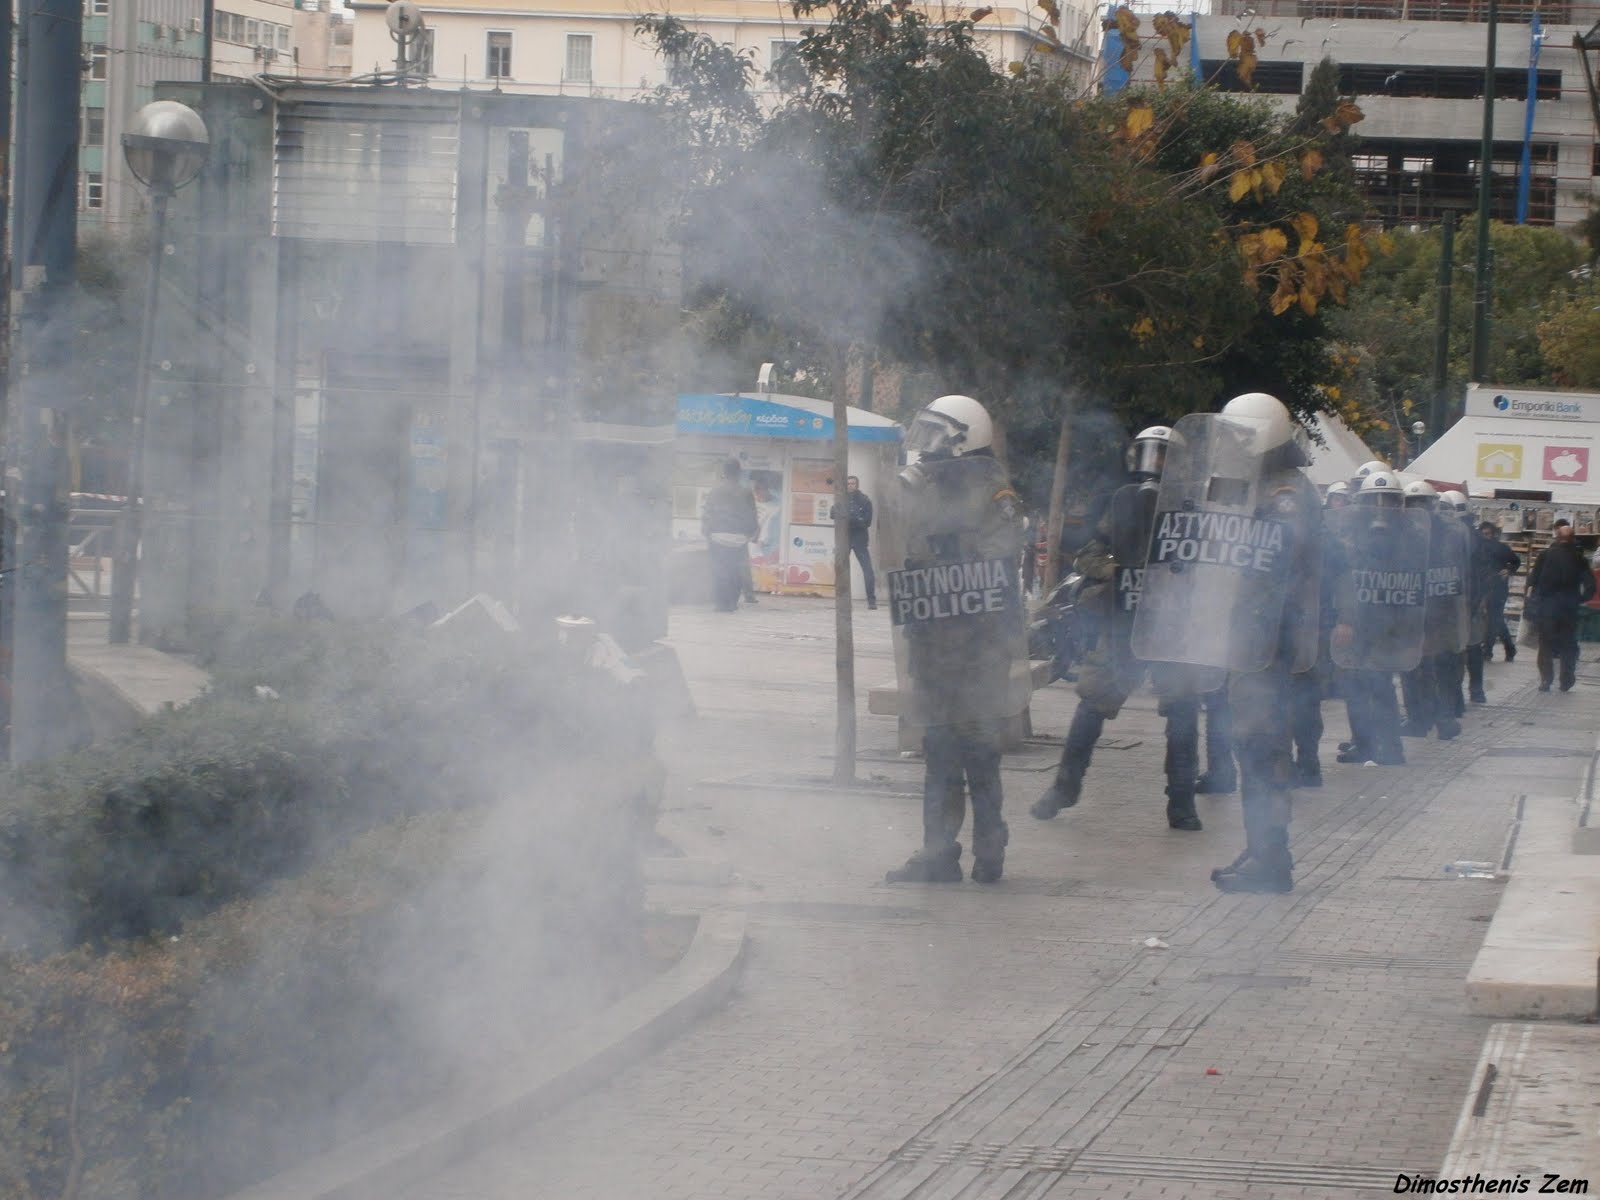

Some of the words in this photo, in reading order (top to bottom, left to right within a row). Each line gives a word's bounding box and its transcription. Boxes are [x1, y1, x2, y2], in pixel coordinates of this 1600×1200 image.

[1511, 400, 1555, 412] Emporiki
[1556, 402, 1582, 413] Bank
[1157, 512, 1282, 551] ΑΣΤΥΝΟΜΙΑ
[1158, 539, 1275, 573] POLICE
[893, 560, 1009, 599] ΑΣΤΥΝΟΜΙΑ
[898, 588, 1005, 623] POLICE
[1356, 588, 1417, 606] OLICE
